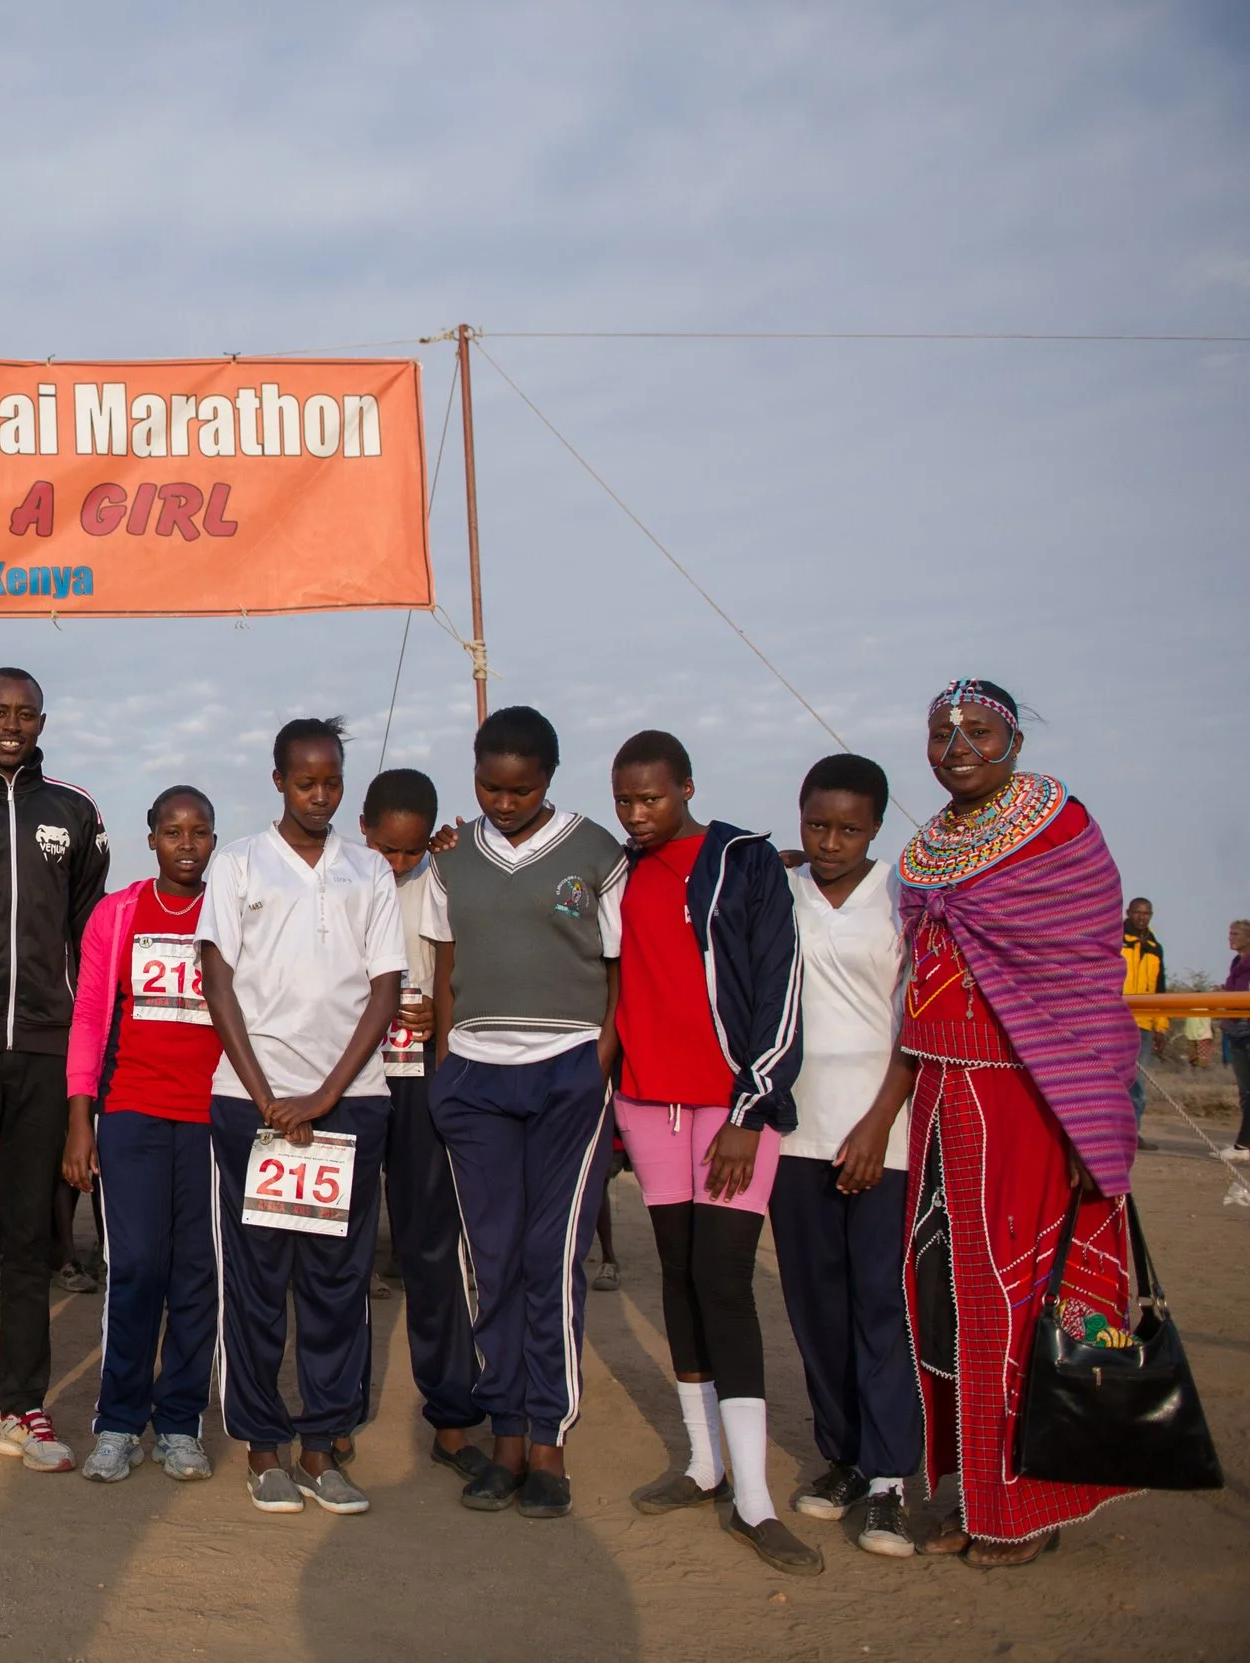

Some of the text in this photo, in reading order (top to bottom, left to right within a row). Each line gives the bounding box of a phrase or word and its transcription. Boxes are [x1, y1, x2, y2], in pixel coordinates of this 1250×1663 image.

[74, 381, 382, 459] Marathon
[9, 480, 55, 538] A
[80, 482, 238, 542] GIRL
[39, 842, 66, 856] VENUM
[256, 1159, 340, 1204] 215
